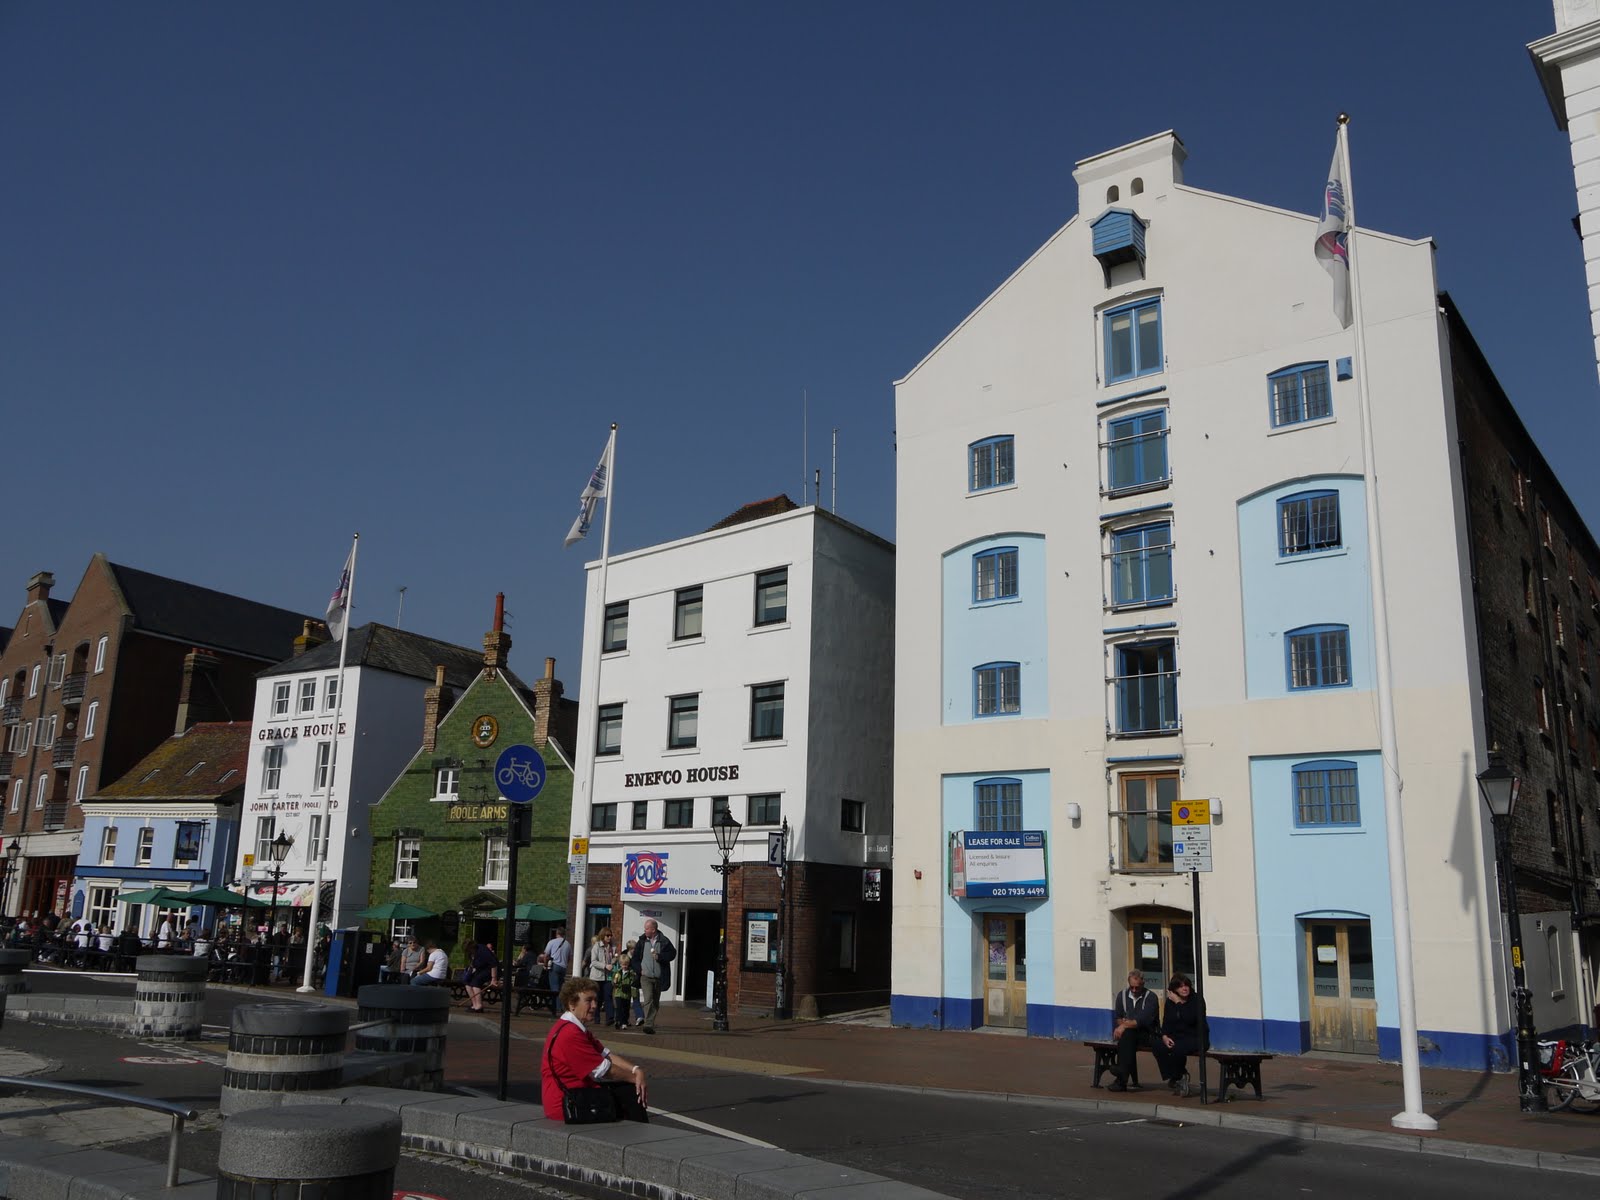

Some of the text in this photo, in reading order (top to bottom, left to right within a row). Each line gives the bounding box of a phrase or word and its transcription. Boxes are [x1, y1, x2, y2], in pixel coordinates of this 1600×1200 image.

[258, 726, 298, 741] GRACE
[624, 764, 739, 788] ENEFCO HOUSE
[250, 802, 269, 812] JOHN
[271, 801, 300, 811] CARTER
[450, 806, 507, 819] POOLE ARMS
[968, 838, 989, 846] LEASE
[669, 887, 723, 896] Welcome Centre
[992, 888, 1007, 896] 020
[1026, 887, 1045, 895] 4499
